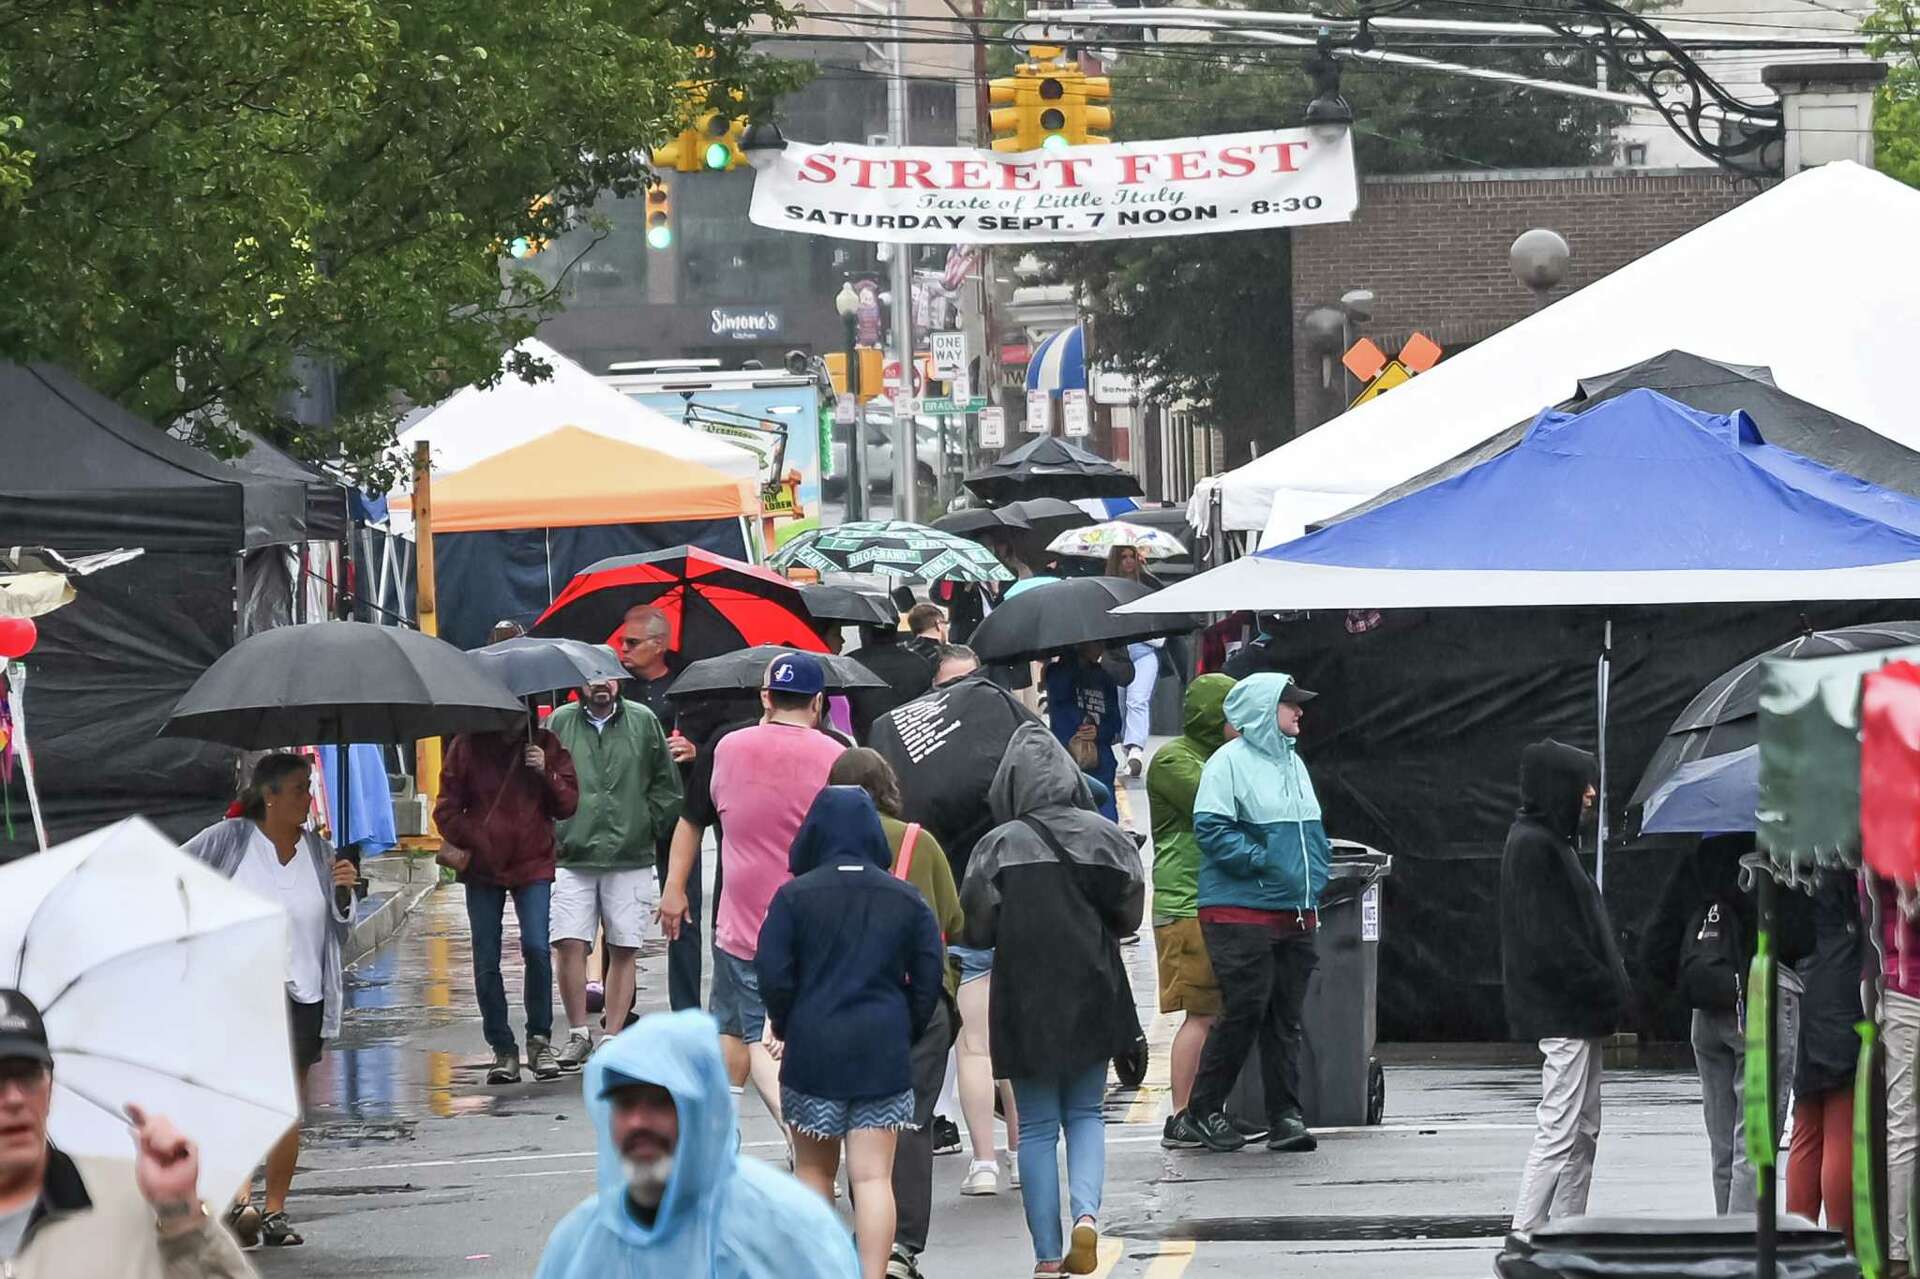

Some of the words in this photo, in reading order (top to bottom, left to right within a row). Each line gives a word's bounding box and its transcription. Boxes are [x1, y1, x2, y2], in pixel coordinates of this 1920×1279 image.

[798, 153, 1092, 190] STREET
[1116, 141, 1308, 185] FEST
[916, 193, 991, 210] Taste
[999, 194, 1024, 213] of
[1034, 191, 1102, 210] Little
[1111, 187, 1185, 205] Italy
[784, 204, 966, 231] SATURDAY
[978, 214, 1074, 231] SEPT.
[1090, 212, 1105, 228] 7
[1118, 204, 1218, 226] NOON
[1251, 195, 1323, 215] 8:30
[711, 309, 777, 334] Simone's
[936, 336, 961, 348] ONE
[935, 350, 962, 361] WAY
